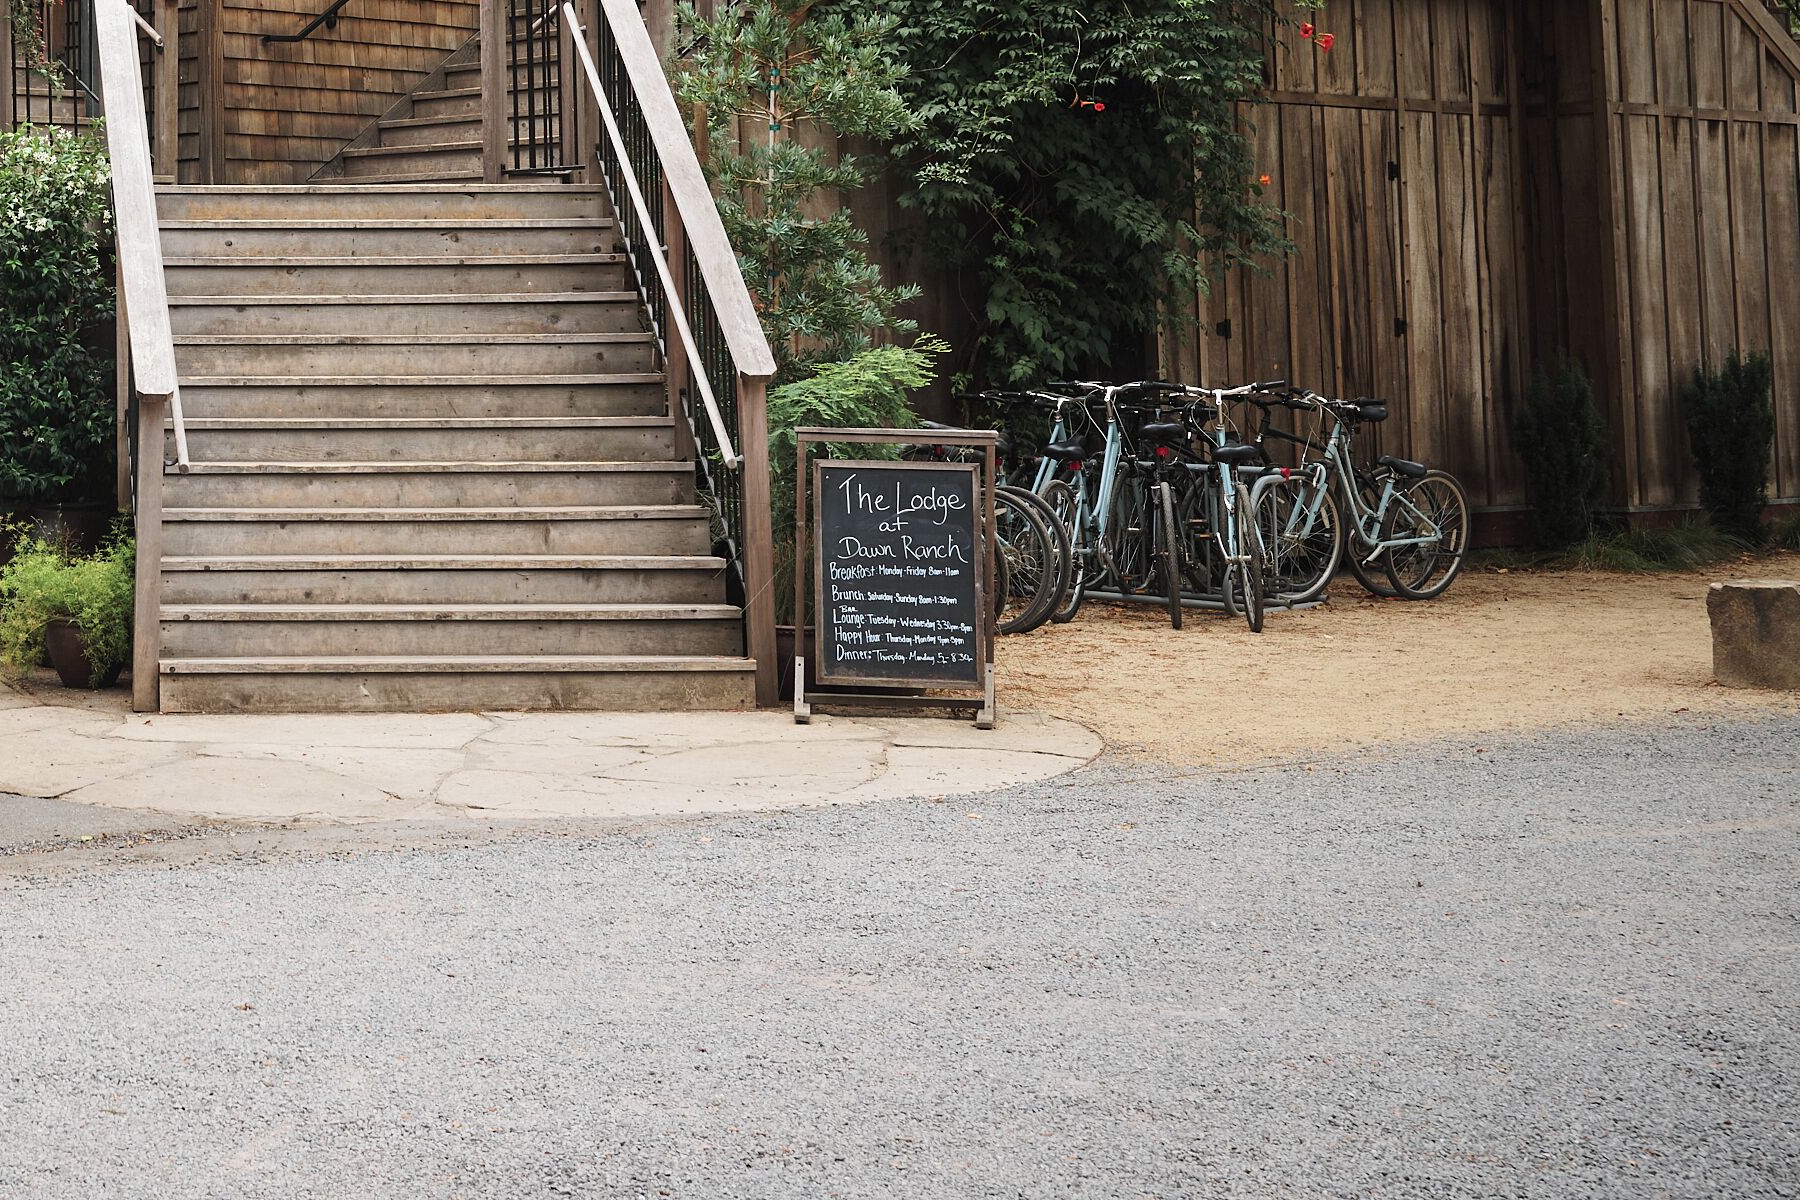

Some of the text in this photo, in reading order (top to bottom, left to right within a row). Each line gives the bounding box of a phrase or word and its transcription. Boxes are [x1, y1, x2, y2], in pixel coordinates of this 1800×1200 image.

[839, 473, 966, 525] The Lodge
[879, 516, 909, 532] at
[838, 534, 969, 563] Dawn Ranch
[829, 561, 878, 580] Breakfast:
[831, 584, 867, 602] Brunch:
[834, 625, 862, 645] Happy
[836, 644, 872, 661] Dinner:
